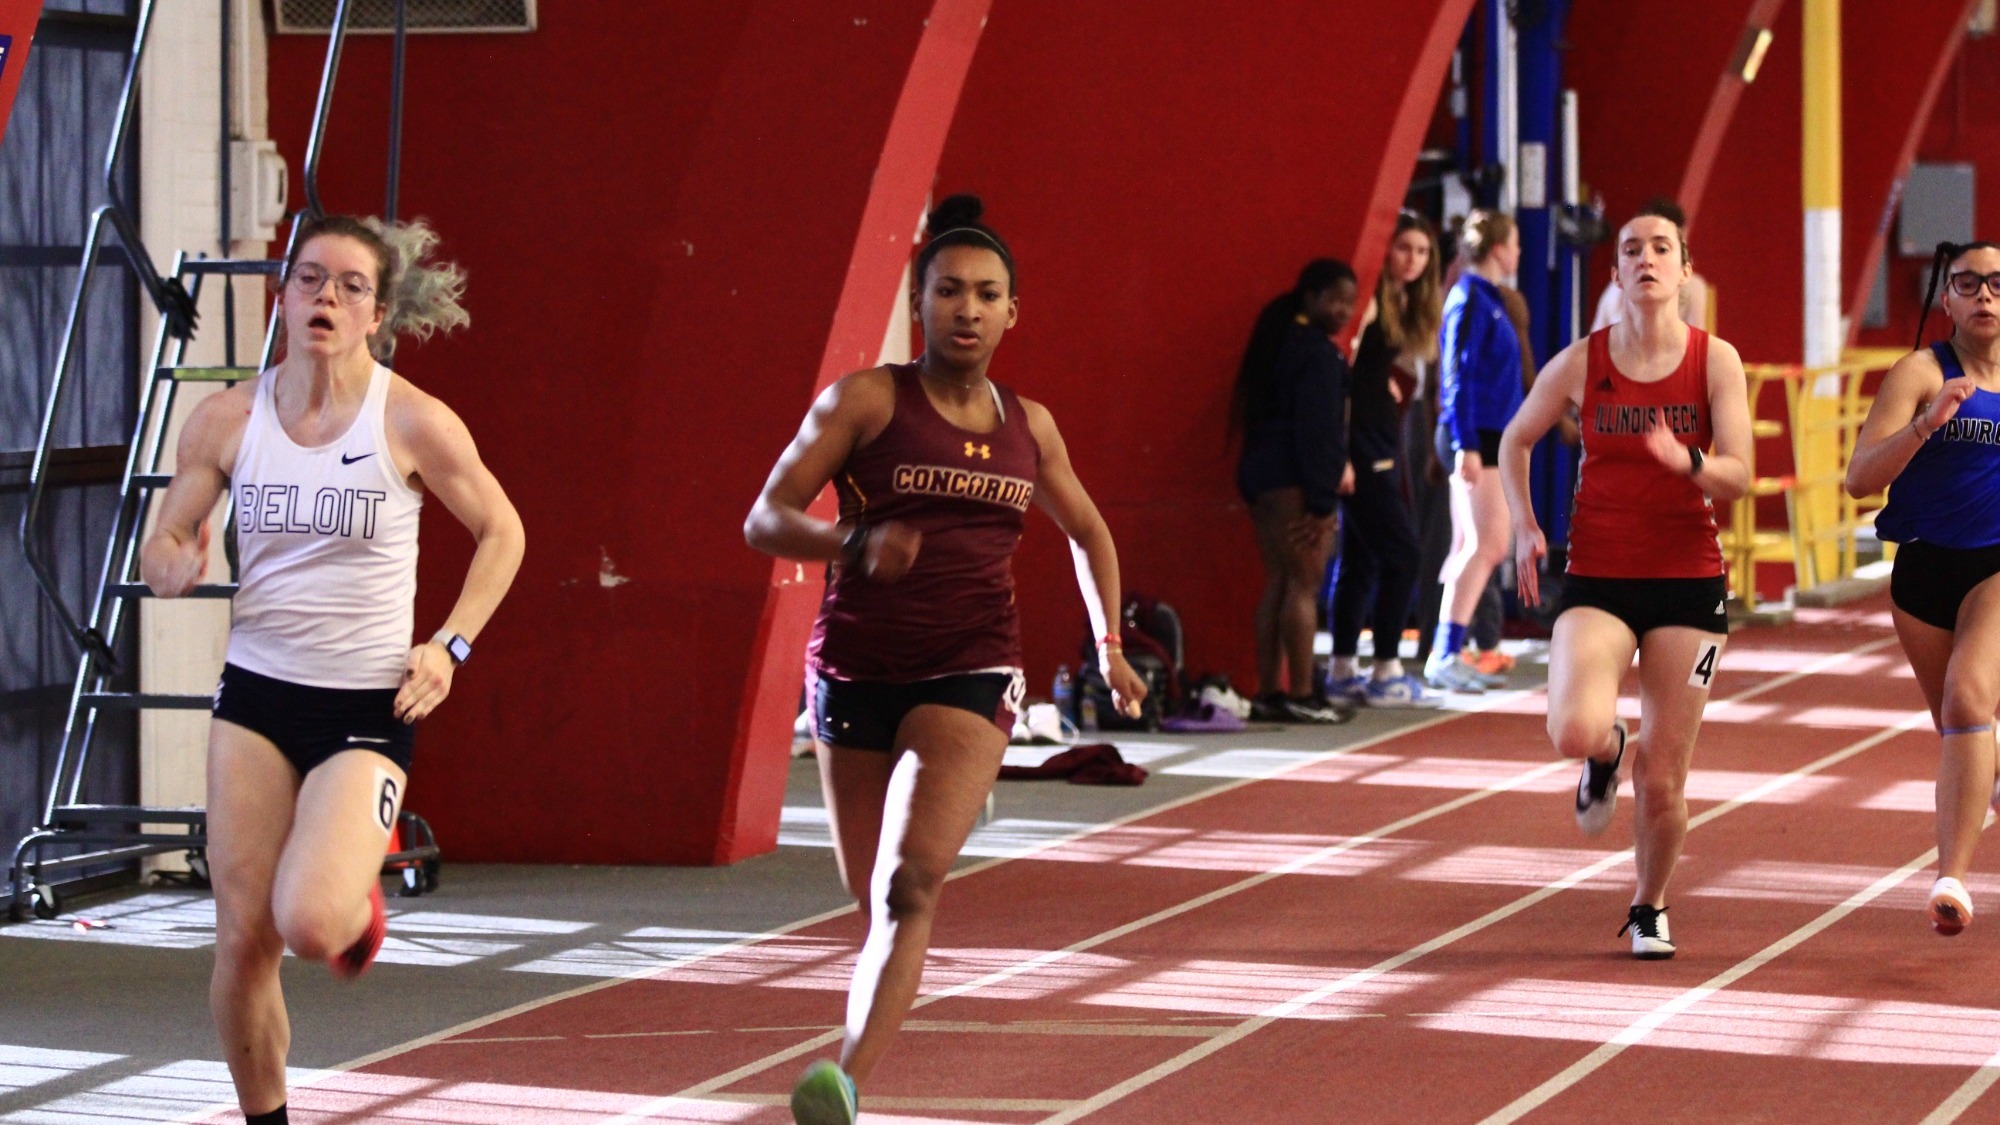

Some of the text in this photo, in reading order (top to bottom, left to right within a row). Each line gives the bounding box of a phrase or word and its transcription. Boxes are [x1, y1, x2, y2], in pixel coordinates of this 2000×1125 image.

[1595, 404, 1698, 434] ILLINOIS TECH
[241, 484, 386, 539] BELOIT
[894, 464, 1034, 512] CONCORDIA
[1695, 645, 1717, 685] 4
[379, 777, 397, 829] 6
